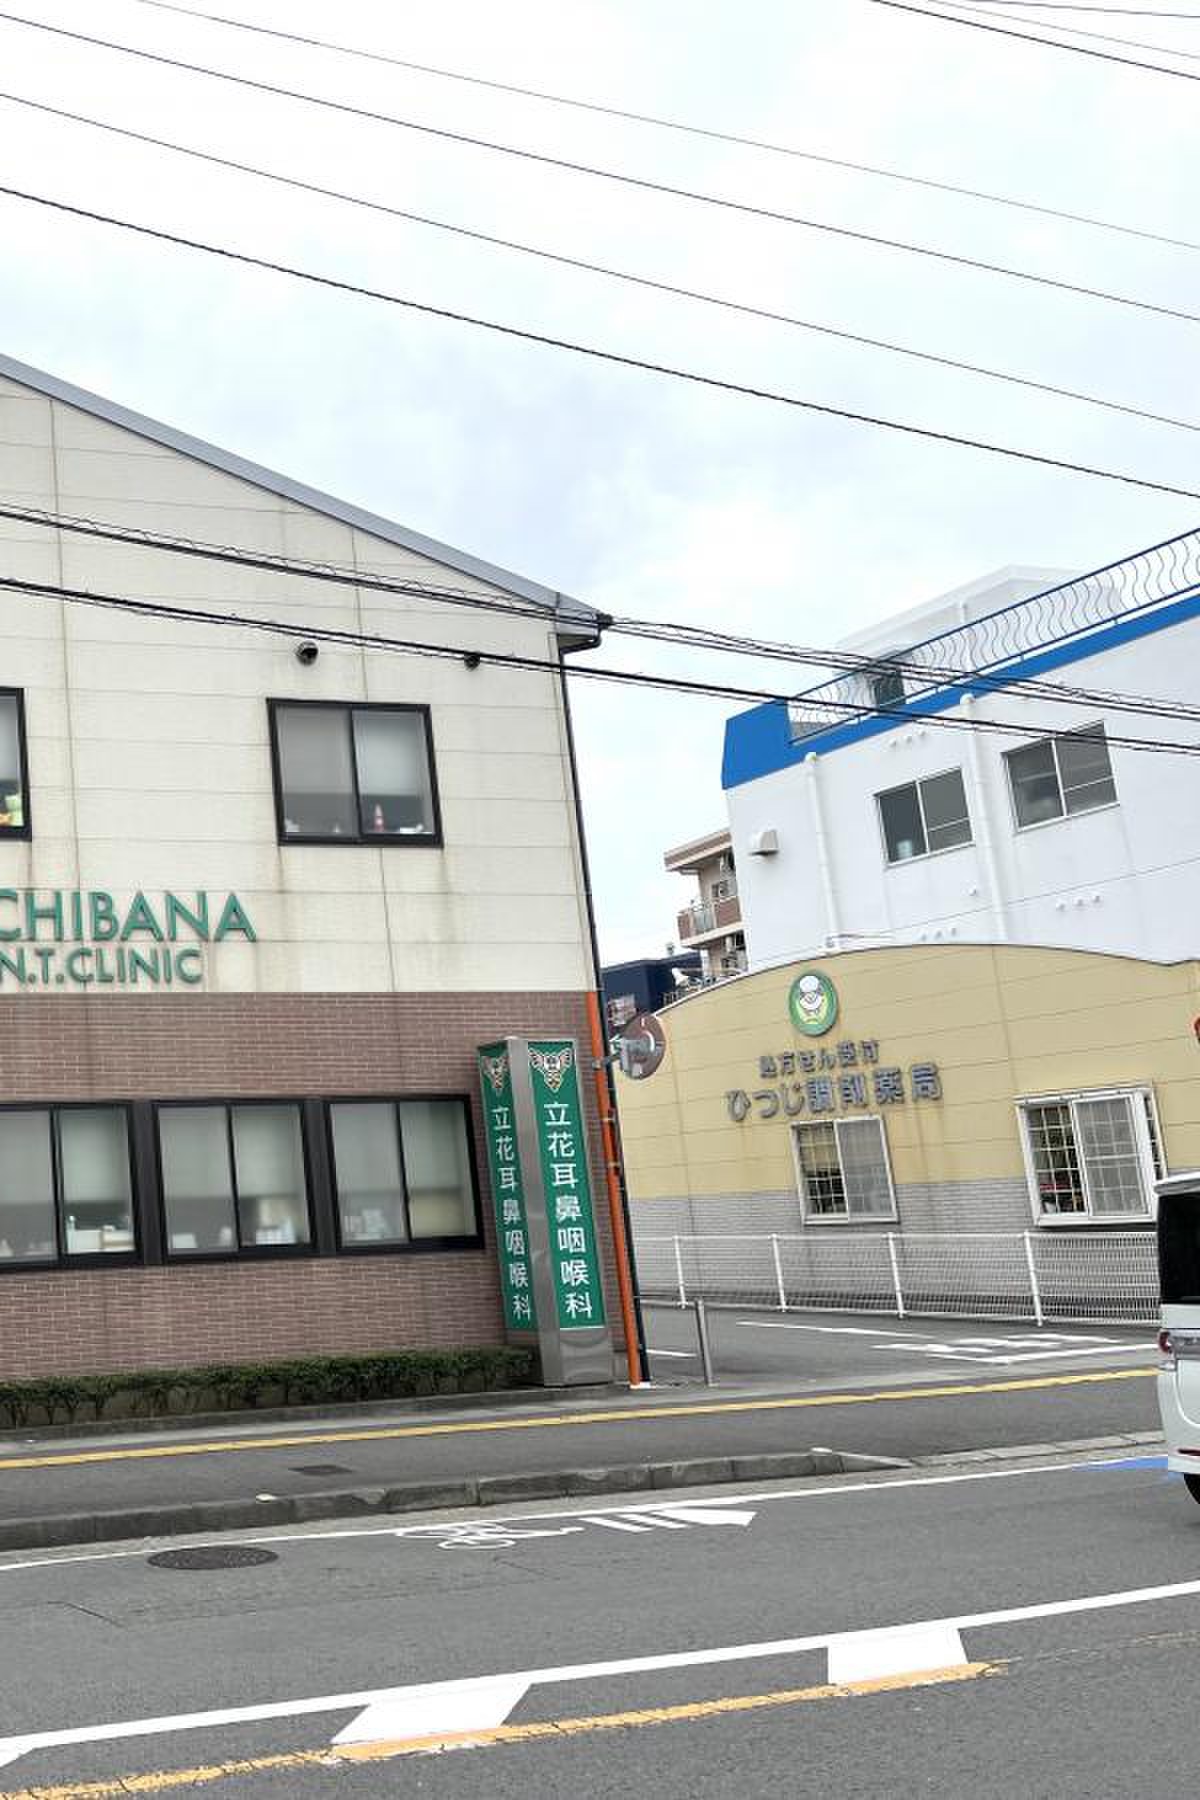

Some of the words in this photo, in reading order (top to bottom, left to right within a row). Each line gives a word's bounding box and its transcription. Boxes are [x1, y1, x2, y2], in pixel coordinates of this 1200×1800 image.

[727, 1062, 943, 1121] ひつじ調剤薬局
[491, 1107, 532, 1320] 立花耳鼻咽喉科
[543, 1101, 593, 1318] 立花耳鼻咽喉科
